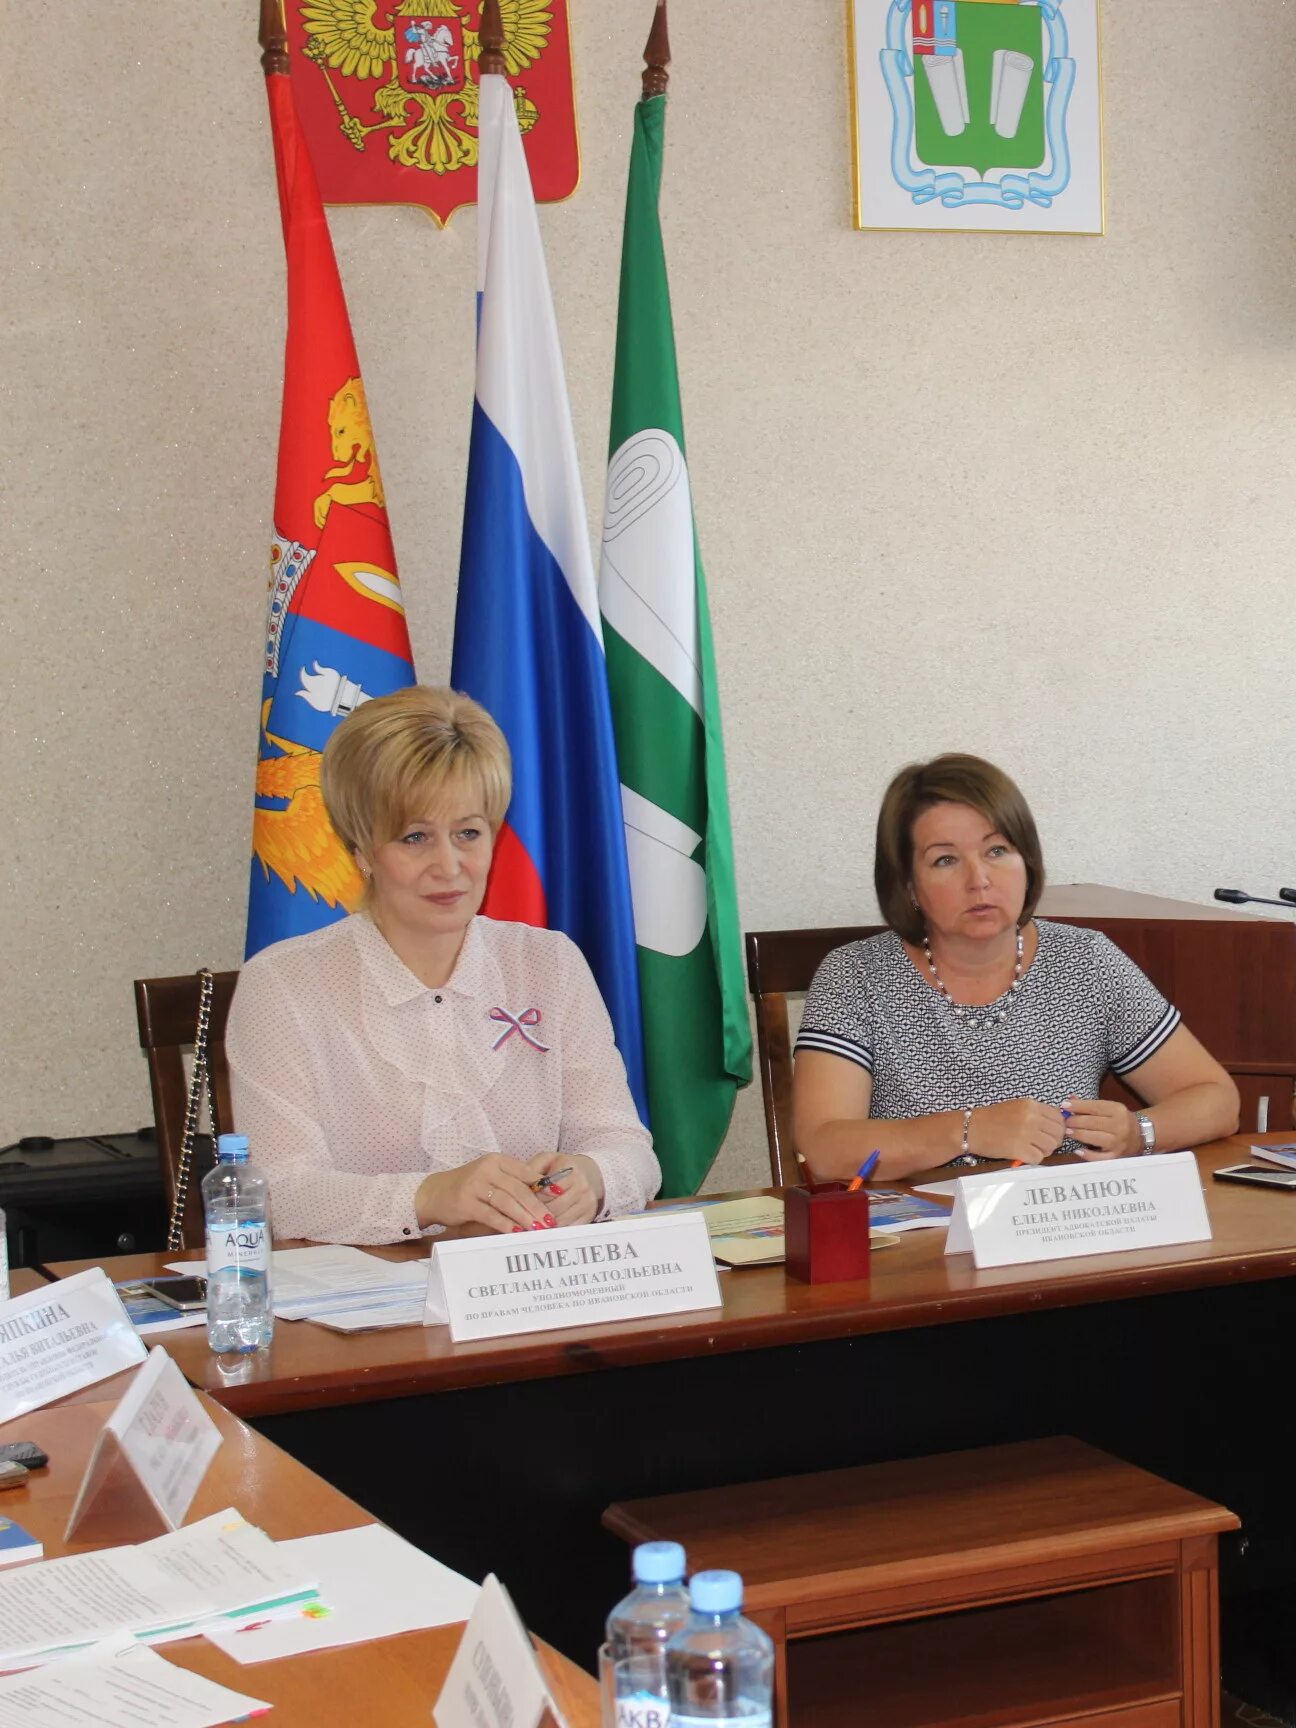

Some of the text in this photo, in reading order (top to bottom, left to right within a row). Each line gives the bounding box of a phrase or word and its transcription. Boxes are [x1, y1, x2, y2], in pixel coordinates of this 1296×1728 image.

[1023, 1178, 1138, 1206] ЛЕВАНЮК
[1012, 1201, 1156, 1226] ЕЛЕНА НИКОЛАЕВНА
[226, 1229, 264, 1248] AQUA
[505, 1241, 640, 1274] ШМЕЛЕВА
[467, 1262, 683, 1299] СВЕТЛАНА АНТАТОЛЬЕВНА
